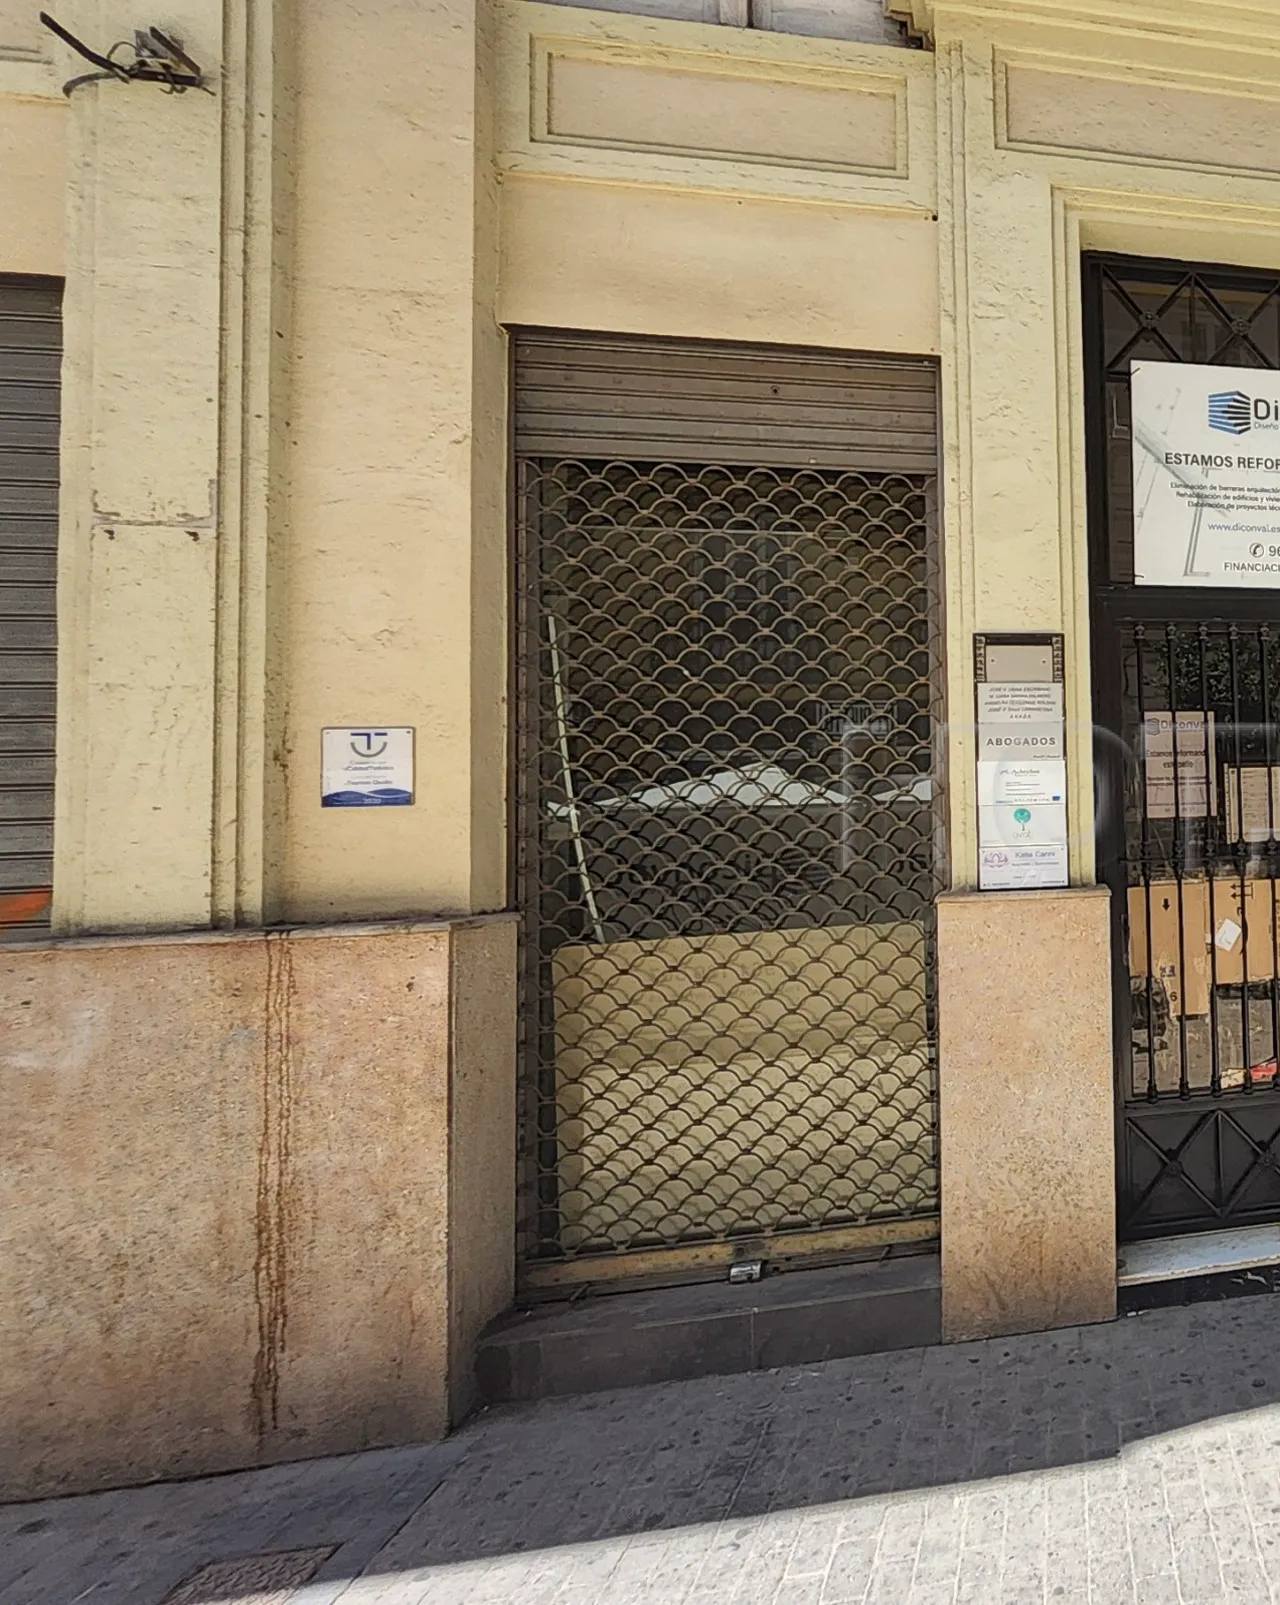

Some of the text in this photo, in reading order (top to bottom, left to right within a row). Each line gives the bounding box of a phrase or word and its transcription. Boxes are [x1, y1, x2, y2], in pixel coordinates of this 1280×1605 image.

[1254, 421, 1279, 431] Diseño
[1165, 452, 1233, 468] ESTAMOS
[1208, 522, 1280, 534] www.diconval.es
[986, 737, 1056, 746] ABOGADOS
